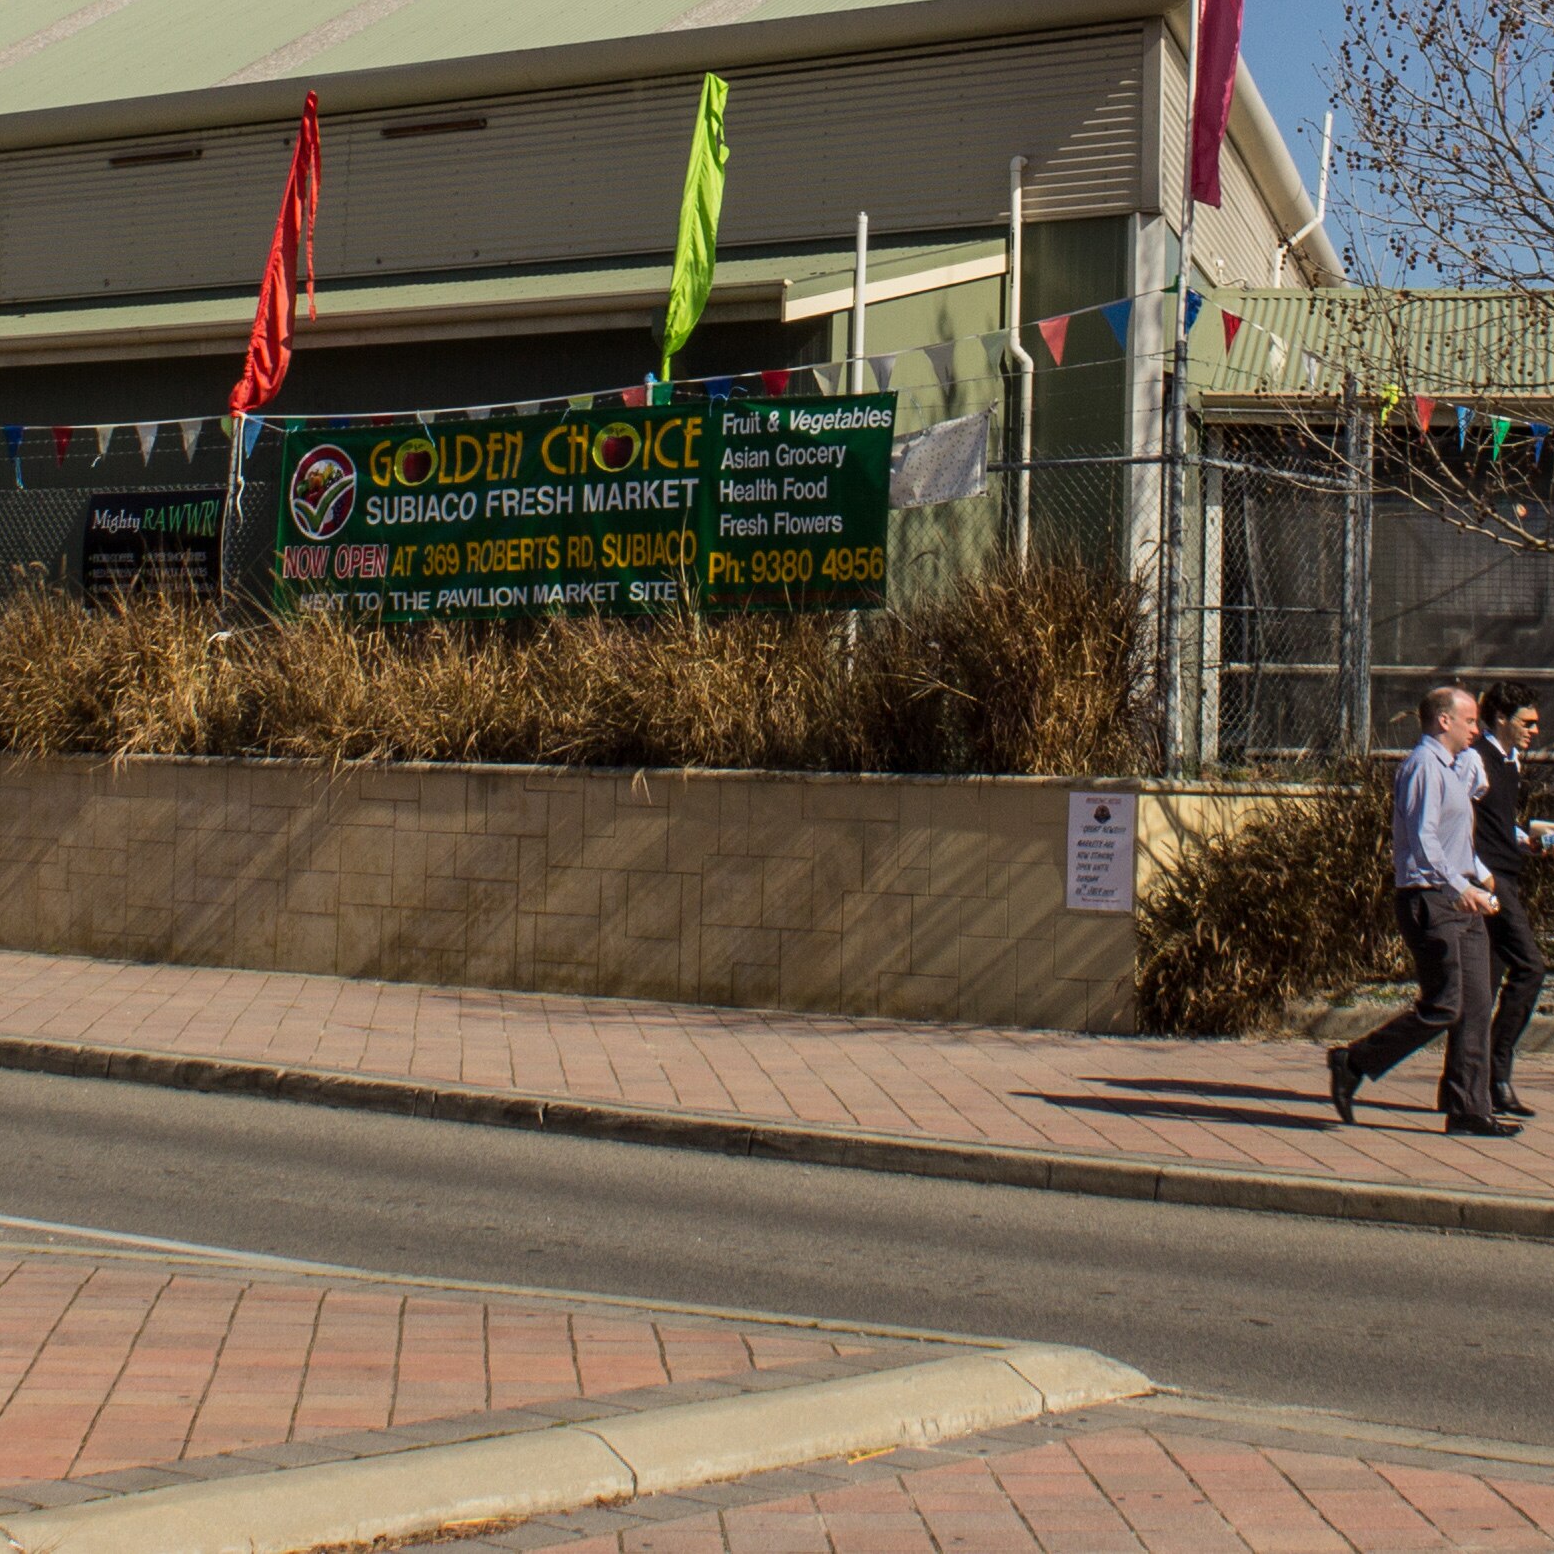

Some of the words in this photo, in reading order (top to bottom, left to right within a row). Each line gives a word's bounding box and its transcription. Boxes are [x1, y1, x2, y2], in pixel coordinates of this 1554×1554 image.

[722, 411, 761, 436] Fruit
[767, 410, 780, 433] &
[789, 406, 892, 435] Vegetables
[370, 429, 523, 487] GOLDEN
[541, 417, 703, 474] CHOICE
[720, 447, 769, 470] Asian
[775, 443, 846, 468] Grocery
[366, 491, 477, 525] SUBIACO
[485, 485, 573, 518] FRESH
[582, 478, 699, 512] MARKET
[719, 478, 777, 502] Health
[782, 475, 828, 500] Food
[92, 509, 140, 533] Mighty
[719, 513, 768, 537] Fresh
[774, 512, 843, 535] Flowers
[283, 545, 330, 580] NOW
[334, 543, 389, 580] OPEN
[391, 545, 417, 577] AT
[422, 542, 460, 576] 369
[466, 534, 560, 573] ROBERTS
[601, 529, 697, 568] SUBIACO
[708, 551, 745, 584] Ph:
[751, 548, 813, 583] 9380
[821, 546, 884, 582] 4956
[354, 592, 382, 611] TO
[389, 591, 430, 610] THE
[436, 585, 527, 610] PAVILION
[533, 581, 620, 605] MARKET
[629, 581, 678, 601] SITE
